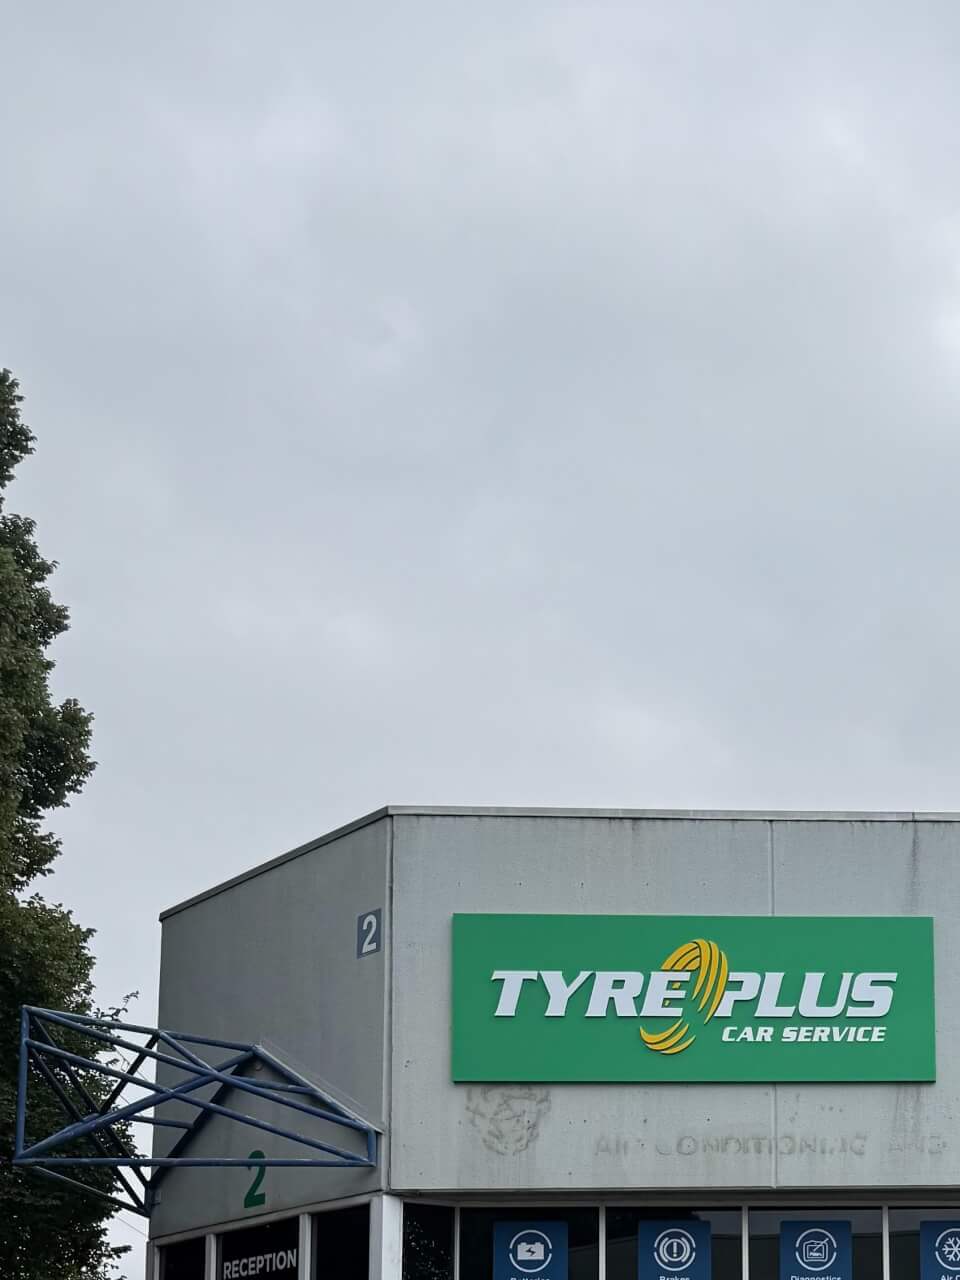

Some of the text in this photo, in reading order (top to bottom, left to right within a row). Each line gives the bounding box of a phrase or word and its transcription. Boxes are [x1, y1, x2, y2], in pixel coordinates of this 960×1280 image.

[362, 914, 377, 953] 2
[722, 1026, 886, 1042] CAR SERVICE
[243, 1149, 266, 1208] 2
[223, 1248, 297, 1280] RECEPTION
